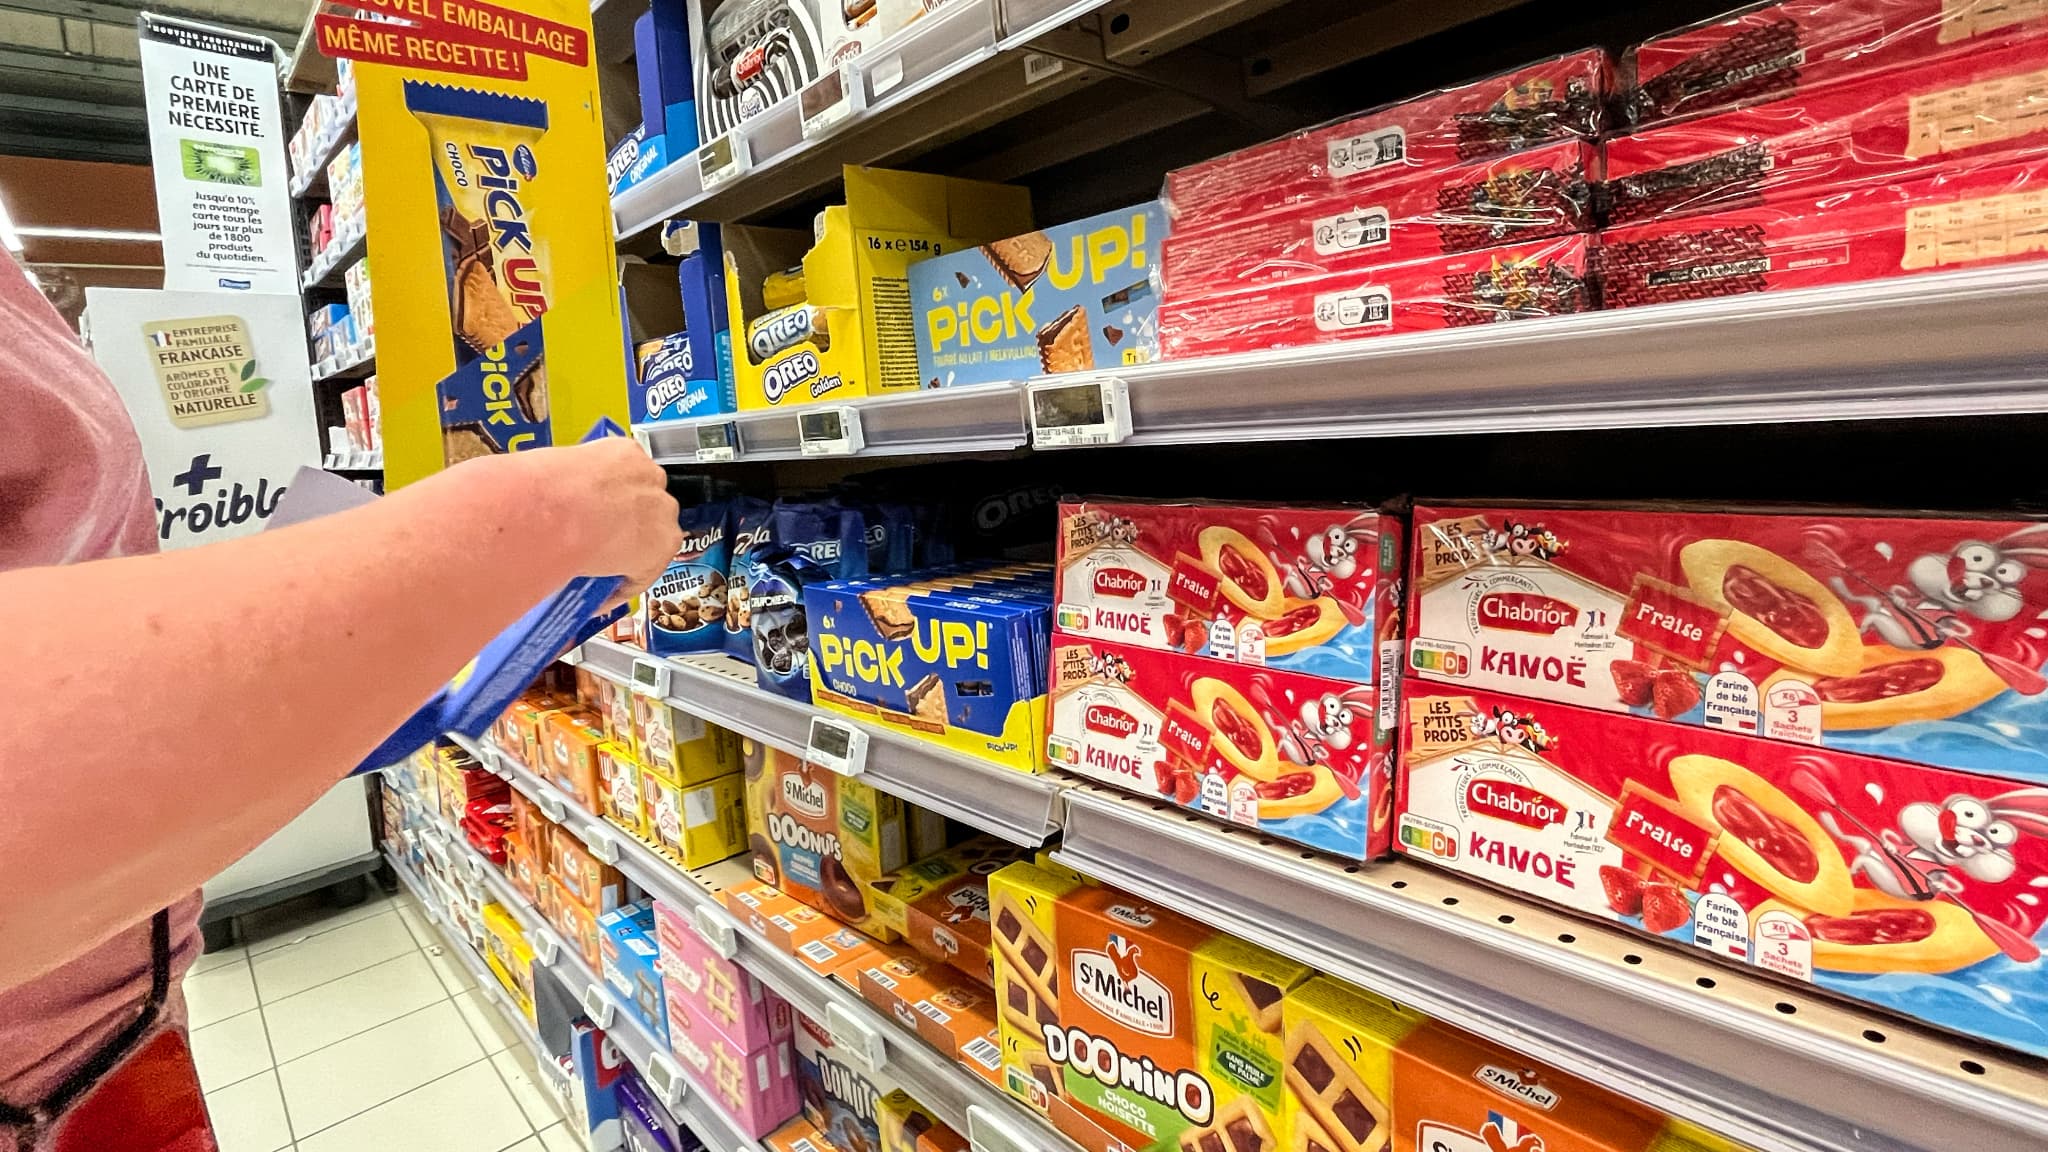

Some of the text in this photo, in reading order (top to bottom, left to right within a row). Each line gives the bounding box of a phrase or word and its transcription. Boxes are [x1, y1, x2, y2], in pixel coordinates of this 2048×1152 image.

[443, 1, 576, 56] EMBALLAGE
[324, 23, 402, 57] MÊME
[405, 37, 510, 71] RECETTE
[193, 61, 230, 81] UNE
[170, 75, 255, 102] CARTE DE
[446, 142, 469, 187] CHOCO
[192, 212, 262, 225] carte tous les
[208, 204, 260, 216] avantage
[193, 221, 264, 235] jours sur plus
[208, 232, 222, 240] de
[196, 250, 211, 259] du
[208, 243, 253, 252] produits
[868, 237, 881, 250] 16
[909, 239, 929, 252] 154
[933, 242, 942, 256] g
[1049, 214, 1146, 291] UP!
[172, 323, 240, 338] ENTREPRISE
[175, 334, 232, 347] FAMILIALE
[752, 308, 808, 358] OREO
[166, 367, 226, 382] ARÔMES ET
[167, 376, 230, 391] COLORANTS
[764, 354, 818, 399] OREO
[170, 384, 232, 400] D'ORIGINE
[647, 373, 686, 414] OREO
[811, 376, 842, 397] Golden
[173, 394, 257, 415] NATURELLE
[676, 387, 708, 415] ORIGINAL
[154, 478, 287, 539] roibl
[662, 567, 691, 584] mini
[1096, 571, 1143, 591] Chabrior
[1488, 575, 1534, 592] COMMERÇANTS
[653, 574, 705, 598] COOKIES
[1175, 572, 1210, 600] Fraise
[1095, 607, 1151, 636] KANOË
[1483, 598, 1571, 626] Chabrior
[1636, 604, 1703, 641] Fraise
[911, 616, 989, 670] UP!
[1063, 658, 1086, 669] P'TITS
[1066, 650, 1079, 660] LES
[1063, 669, 1088, 680] PRODS
[1480, 645, 1587, 689] KANOË
[832, 678, 857, 696] CHOCO
[1716, 679, 1749, 692] Farine
[1428, 701, 1451, 714] LES
[1716, 692, 1748, 703] de blé
[1706, 702, 1757, 717] Française
[1788, 710, 1798, 723] 3
[1087, 707, 1135, 733] Chabrior
[1423, 713, 1463, 729] P'TITS
[1773, 720, 1812, 733] Sachets
[1167, 720, 1203, 751] Fraise
[1424, 727, 1467, 742] PRODS
[1086, 743, 1142, 780] KANOË
[1478, 762, 1524, 783] COMMERÇANTS
[792, 783, 824, 809] Michel
[1471, 782, 1559, 822] Chabrior
[1625, 809, 1693, 859] Fraise
[1469, 831, 1576, 890] KANOË
[1706, 899, 1739, 916] Farine
[1706, 912, 1738, 929] de blé
[1696, 921, 1747, 944] Française
[1778, 942, 1788, 955] 3
[1763, 951, 1803, 968] Sachets
[1094, 968, 1164, 1022] Michel
[1225, 1051, 1244, 1068] SANS
[1494, 1073, 1553, 1106] Michel
[1104, 1089, 1147, 1119] CHOCO
[1098, 1096, 1156, 1136] NOISETTE
